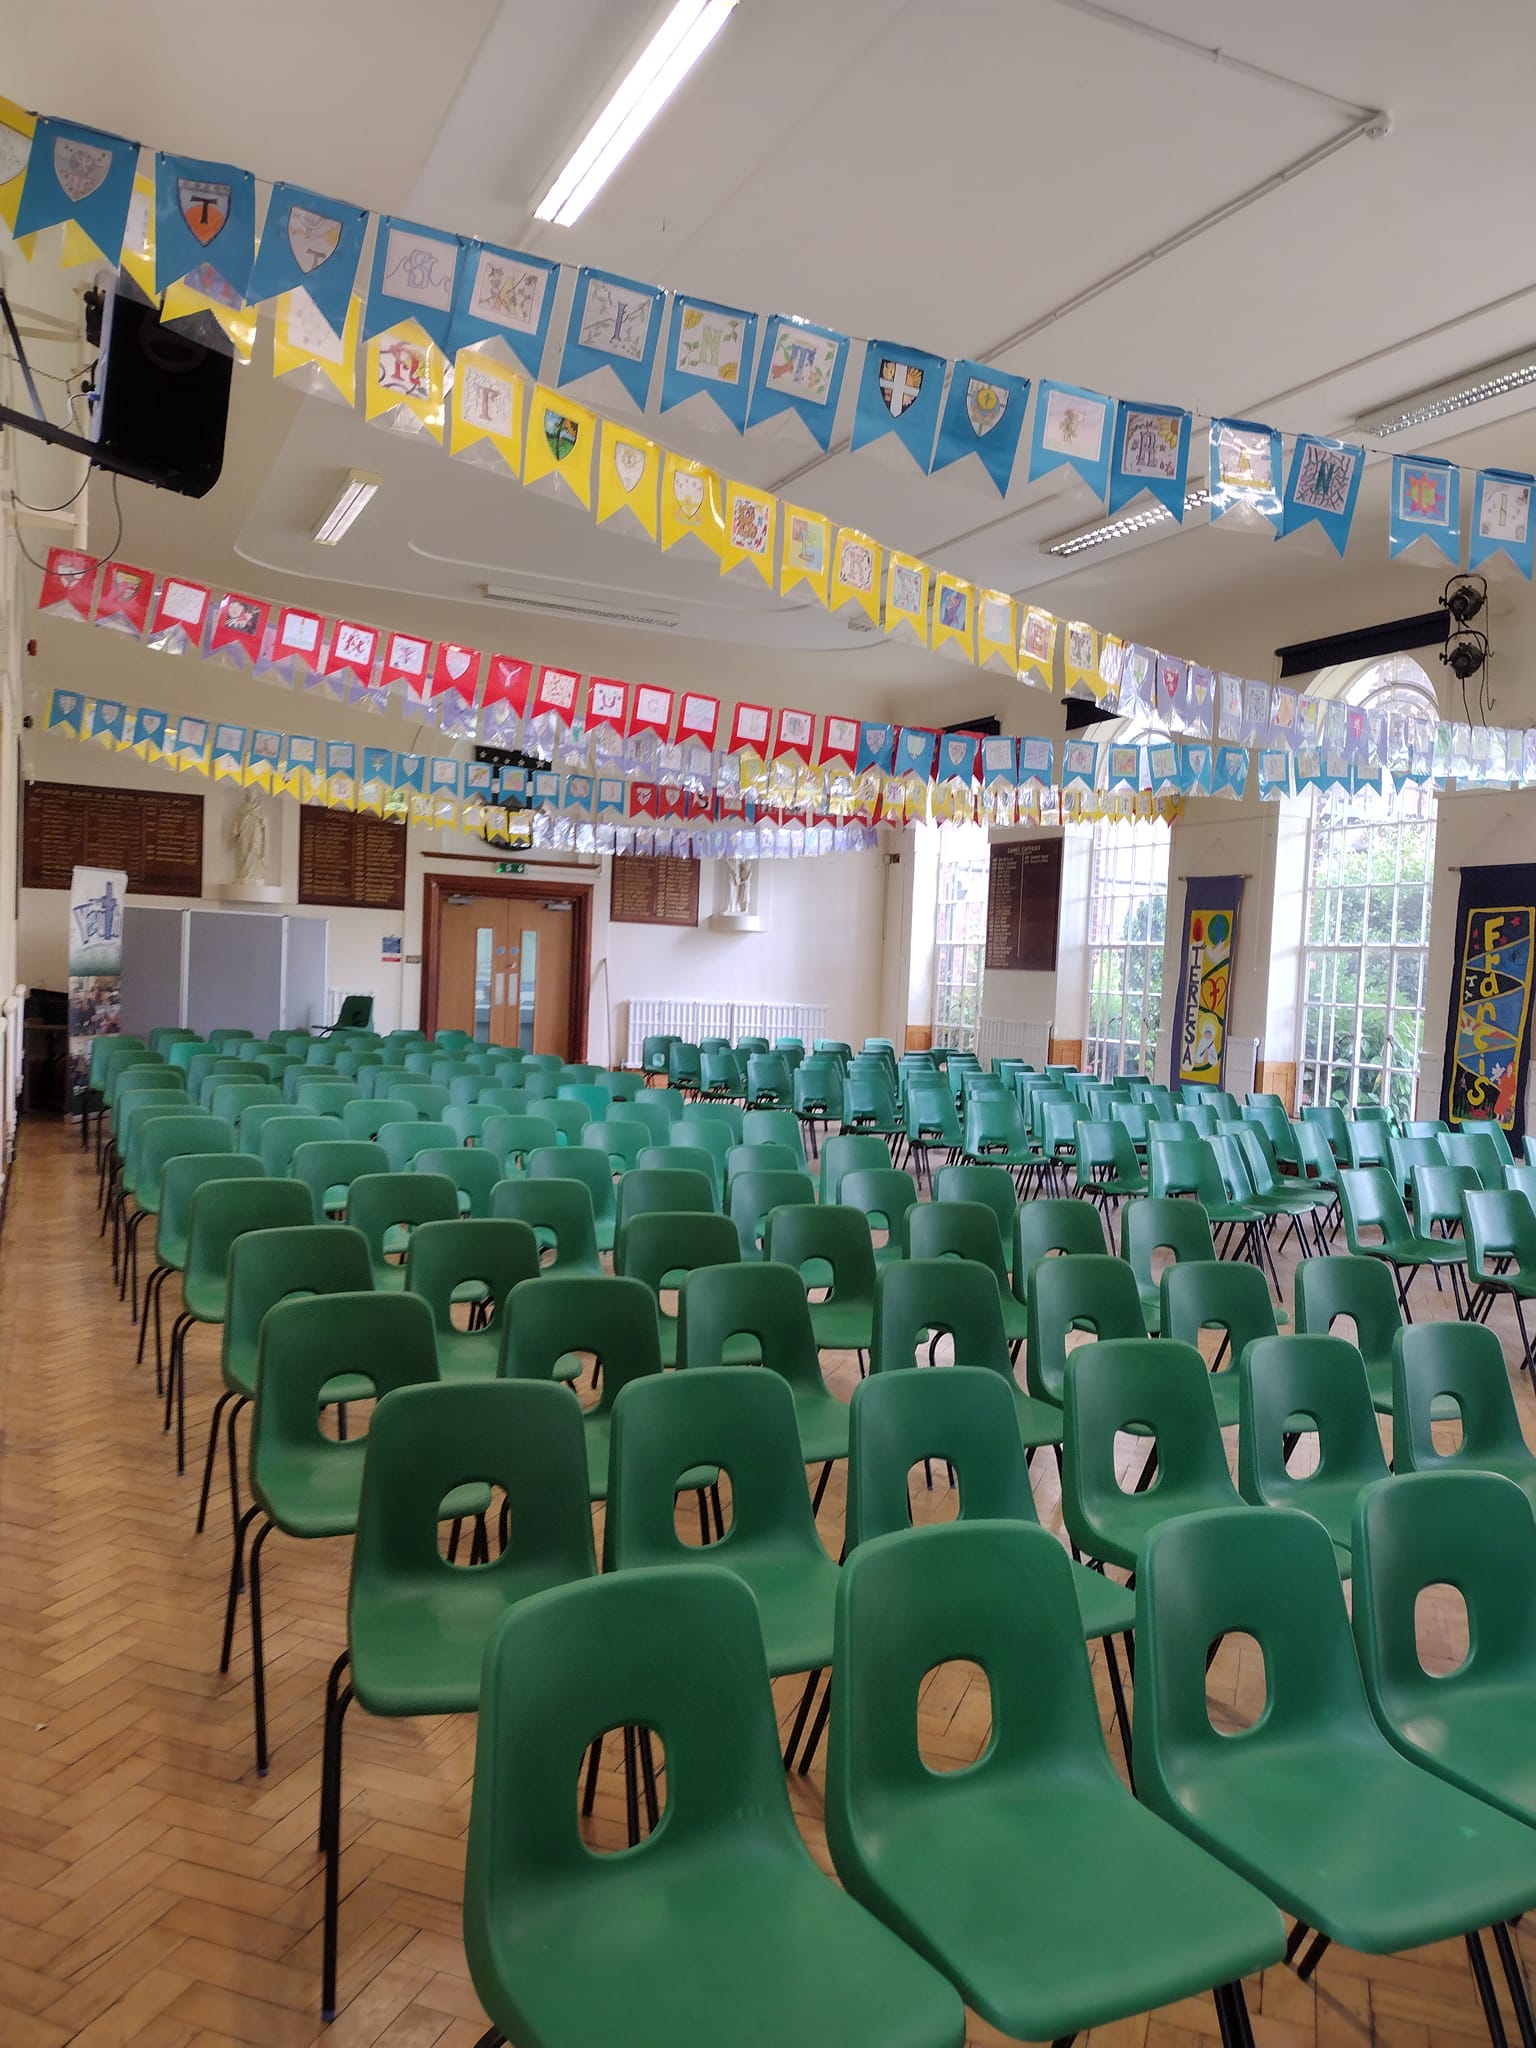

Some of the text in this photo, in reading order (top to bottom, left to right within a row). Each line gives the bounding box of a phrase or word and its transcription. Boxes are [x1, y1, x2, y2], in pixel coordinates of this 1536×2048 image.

[700, 325, 723, 367] N
[790, 343, 817, 385] T
[1314, 460, 1335, 496] N
[1182, 946, 1202, 1065] TERESA
[1467, 916, 1505, 1106] Francis
